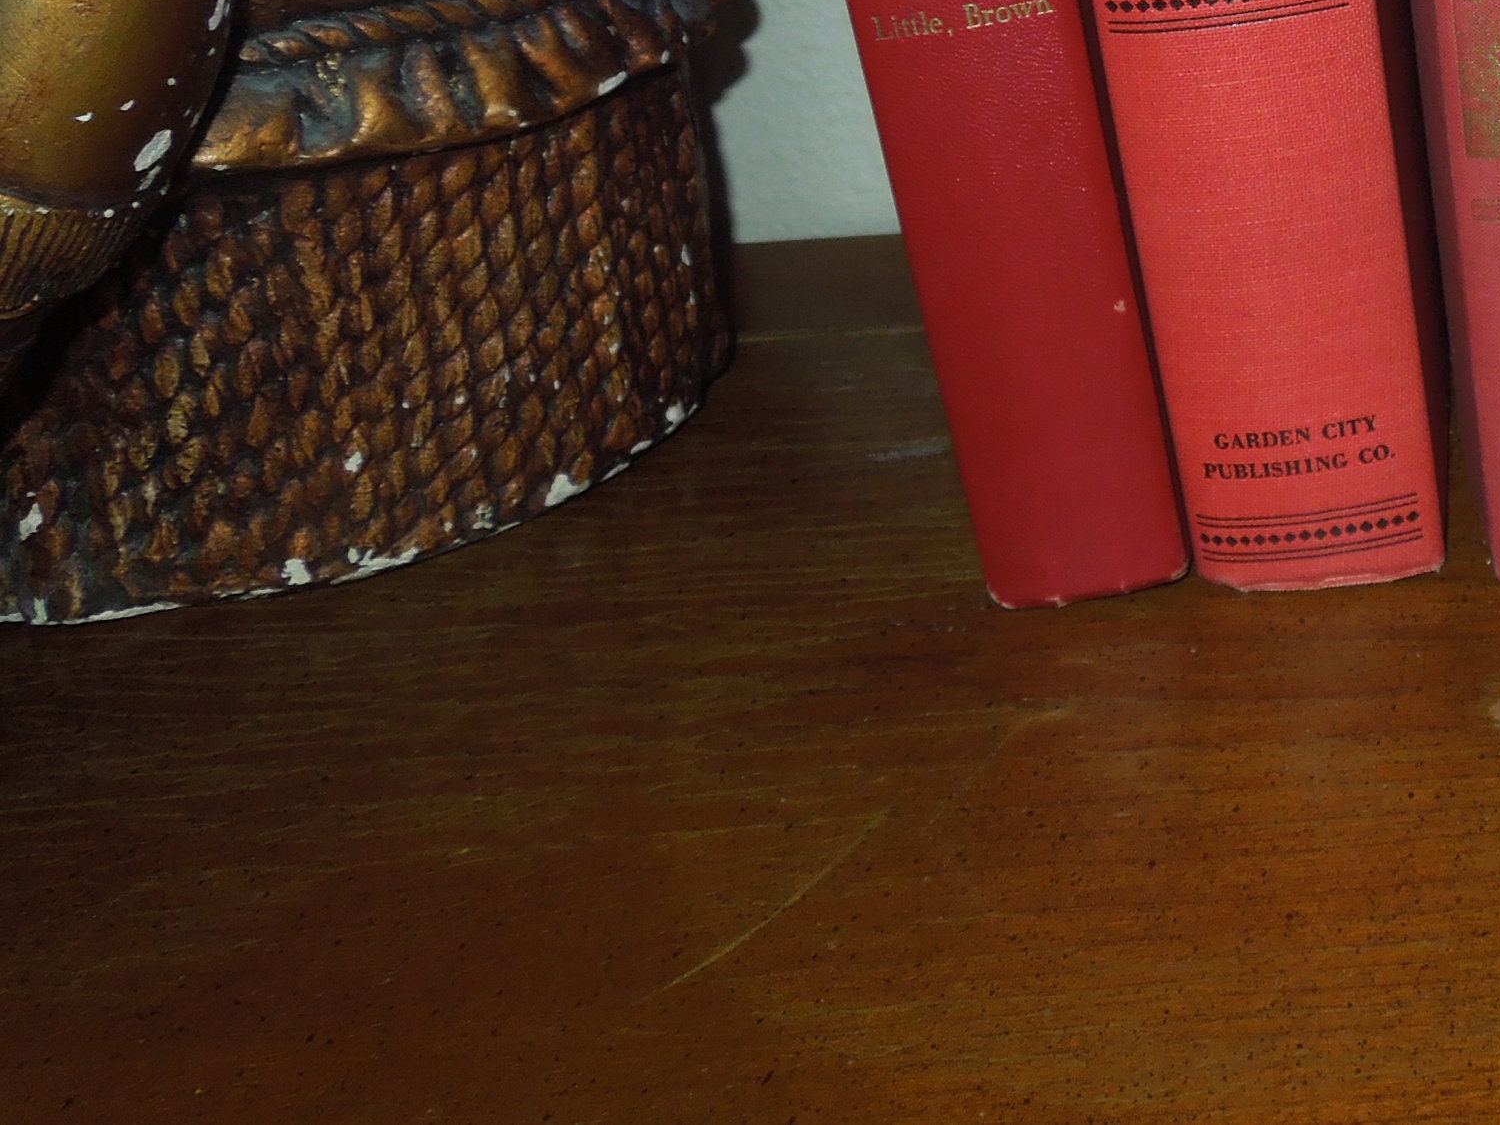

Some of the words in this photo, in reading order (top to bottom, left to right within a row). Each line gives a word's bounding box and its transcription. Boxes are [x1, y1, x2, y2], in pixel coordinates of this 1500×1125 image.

[871, 10, 954, 42] Little,
[1214, 427, 1312, 450] GARDEN
[1322, 414, 1377, 441] CITY
[1203, 453, 1349, 480] PUBLISHING
[1358, 444, 1397, 465] CO.
